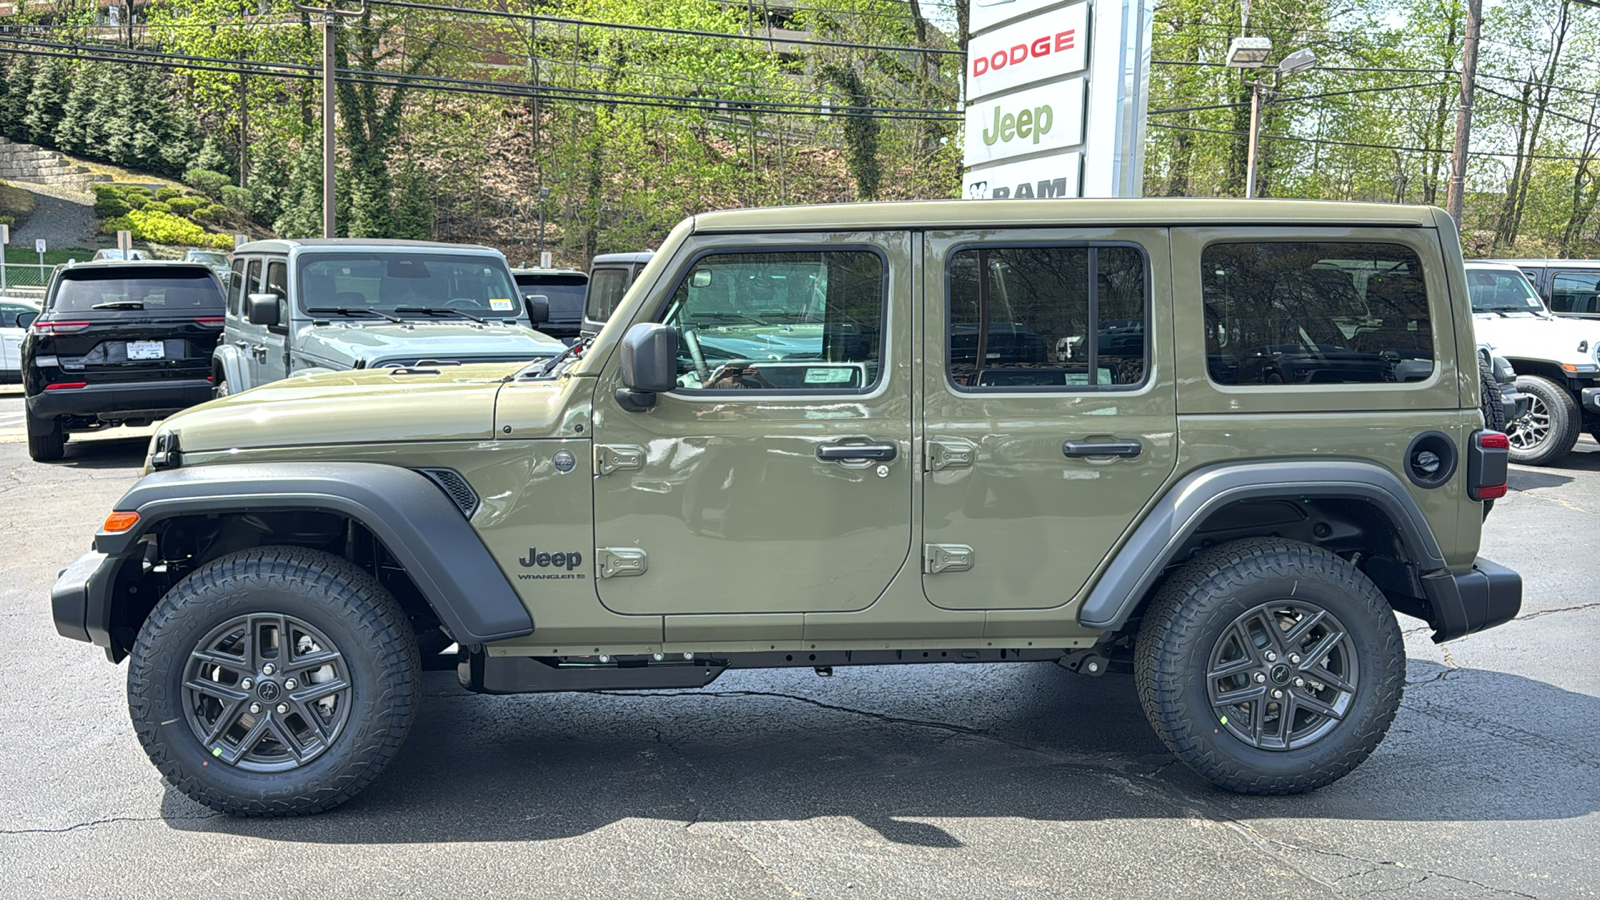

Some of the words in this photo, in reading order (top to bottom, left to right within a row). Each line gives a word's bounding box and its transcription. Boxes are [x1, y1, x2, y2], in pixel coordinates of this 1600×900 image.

[973, 29, 1075, 77] DODGE
[983, 104, 1053, 146] Jeep
[993, 177, 1066, 199] RAM
[519, 547, 582, 571] Jeep
